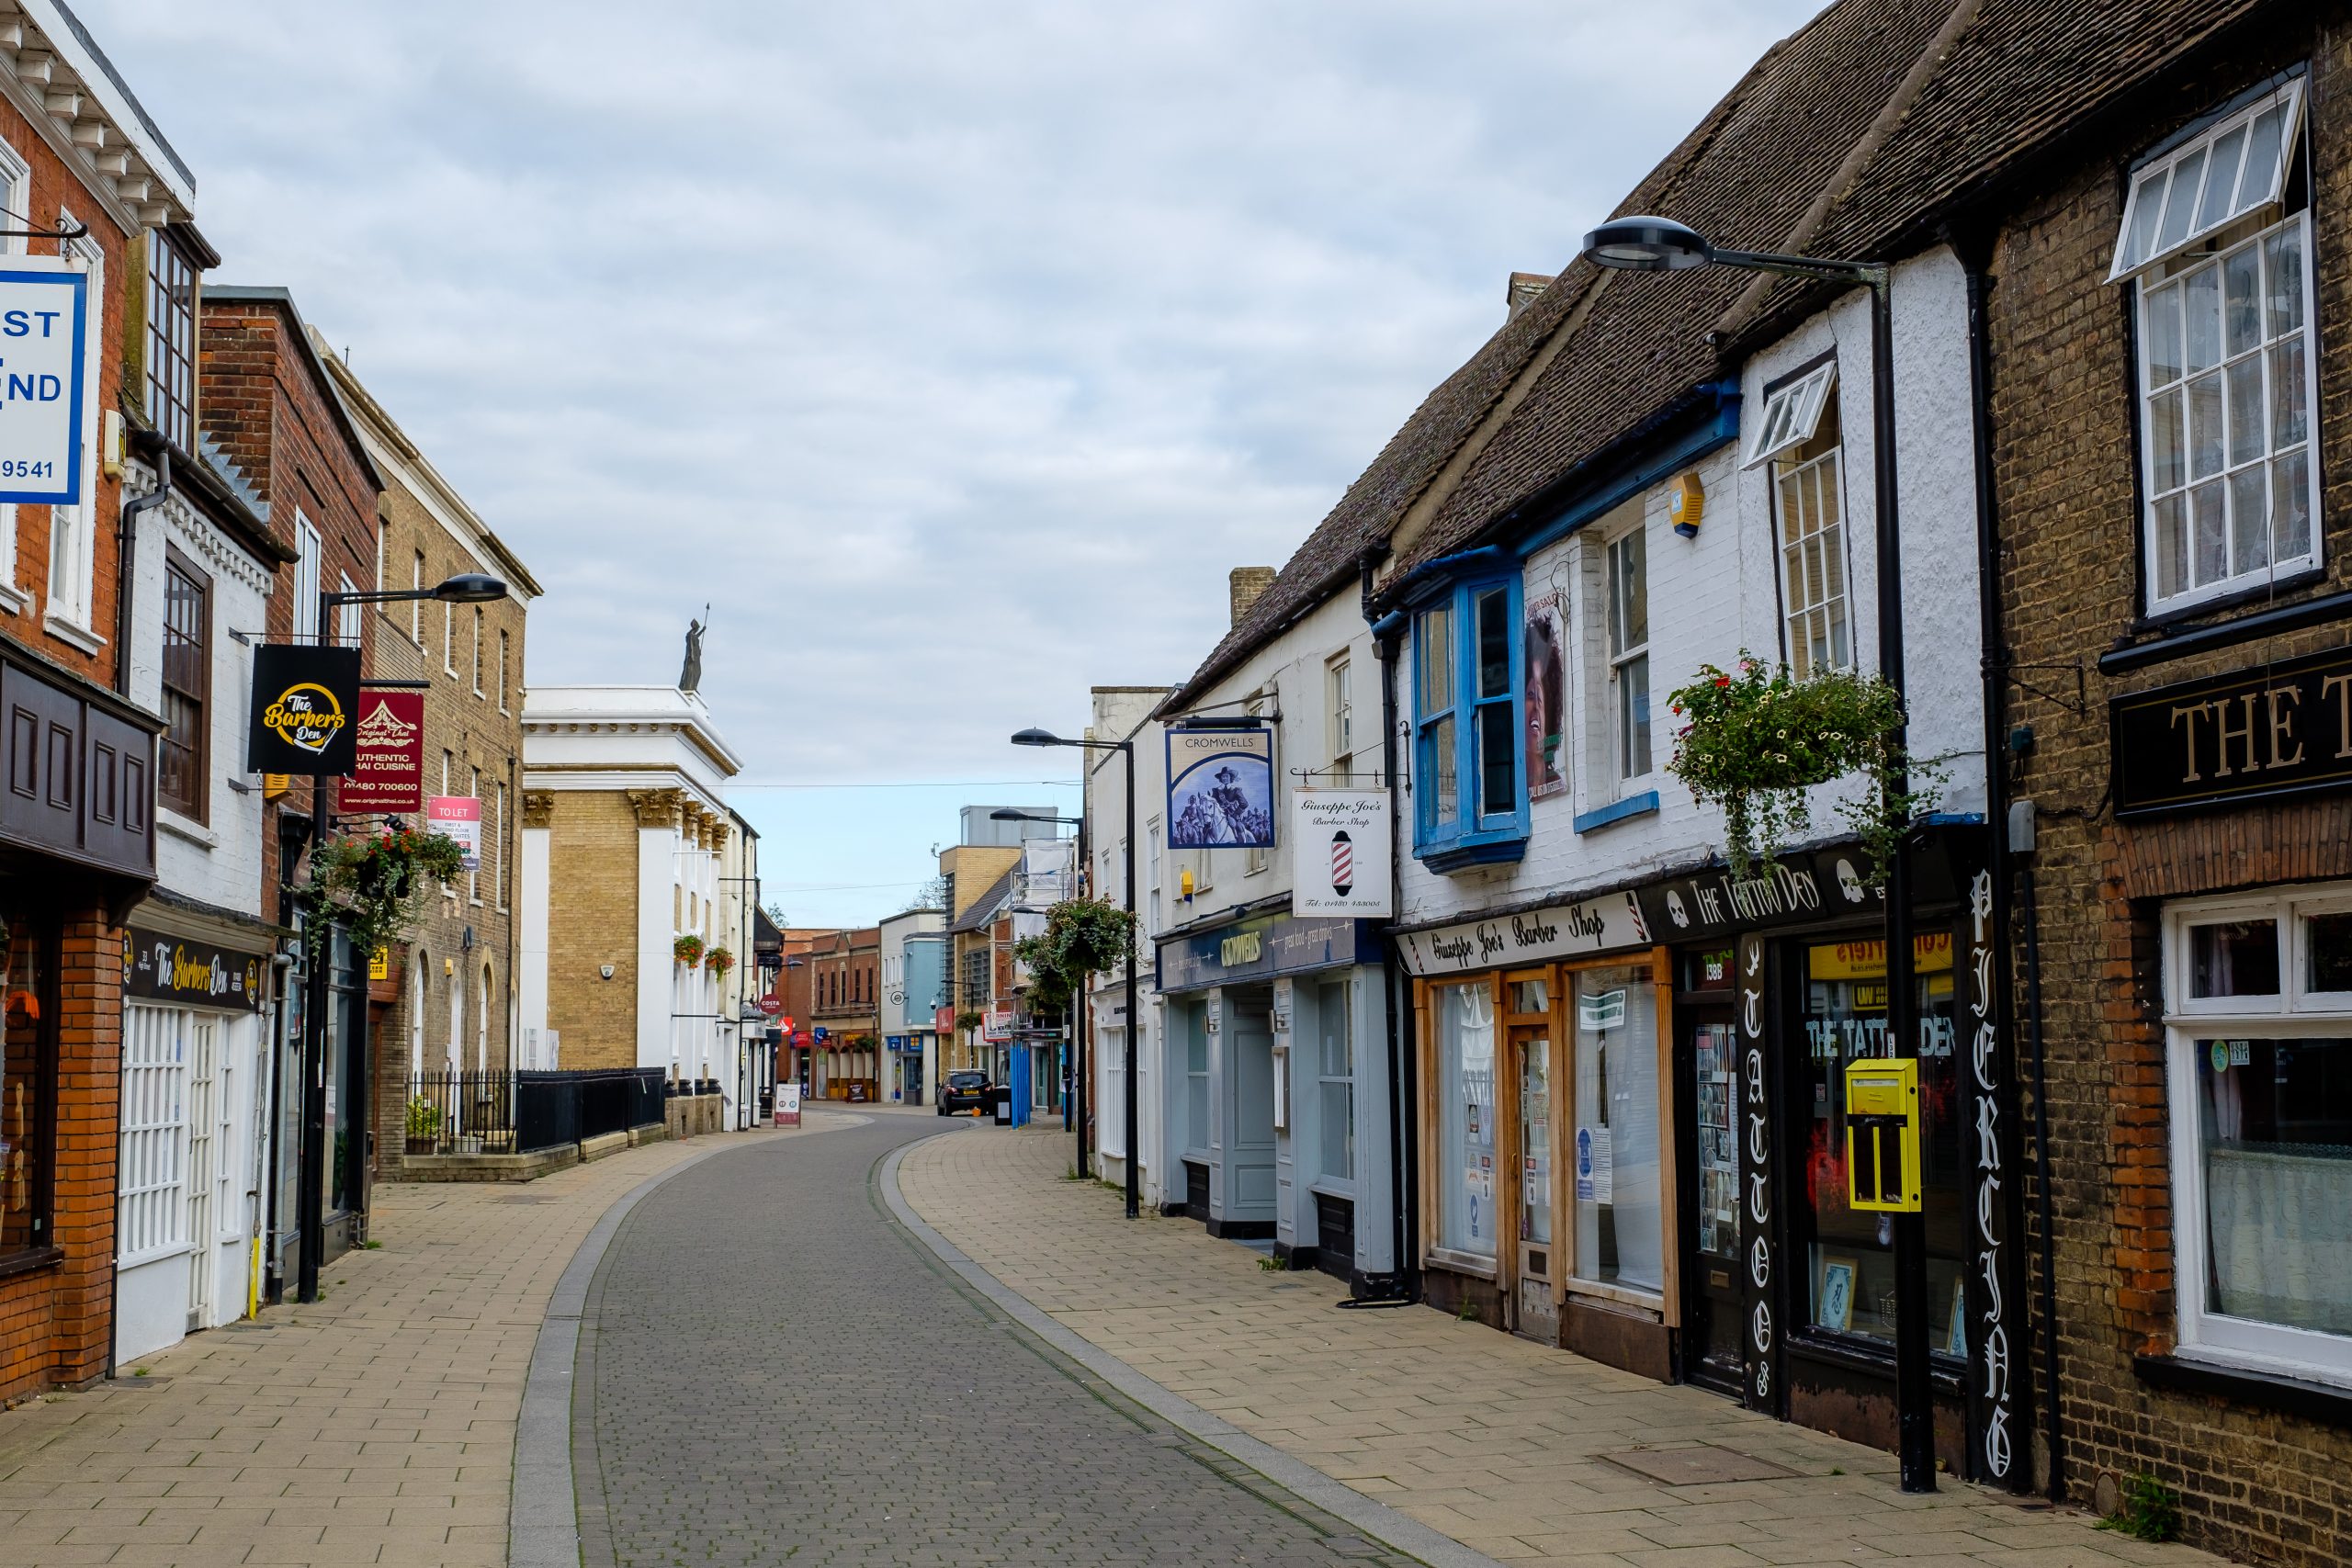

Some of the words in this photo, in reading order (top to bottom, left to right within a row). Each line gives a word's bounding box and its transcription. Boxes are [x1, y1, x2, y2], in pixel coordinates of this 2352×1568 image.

[3, 310, 61, 338] ST
[7, 373, 62, 401] ND
[3, 460, 52, 478] 9541
[287, 695, 313, 712] The
[264, 703, 345, 728] Barbers
[296, 726, 322, 740] Den
[388, 728, 410, 738] Thai
[1185, 738, 1253, 748] CROMWELLS
[2171, 684, 2304, 783] THE
[356, 754, 410, 762] UTHENTIC
[356, 762, 371, 771] HAI
[373, 762, 416, 771] CUISINE
[379, 783, 418, 791] 700600
[438, 807, 451, 817] TO
[452, 808, 469, 818] LET
[1301, 799, 1351, 814] Giuseppe
[1351, 800, 1382, 814] Joe's
[1312, 817, 1345, 826] Barber
[1347, 817, 1370, 828] Shop
[1689, 878, 1727, 924] THE
[1779, 864, 1820, 911] DEN
[1284, 933, 1295, 955] great
[1295, 926, 1305, 947] food
[1307, 928, 1318, 950] great
[1318, 921, 1333, 942] drinks
[1430, 931, 1474, 967] Giuseppe
[1476, 923, 1504, 964] Joe's
[1511, 914, 1558, 947] Barber
[1568, 904, 1605, 947] Shop
[1221, 931, 1261, 967] CROMWELLS
[155, 942, 173, 987] The
[174, 944, 210, 991] Barbers
[209, 953, 228, 997] Den
[1706, 963, 1723, 981] 138B
[1805, 1020, 1838, 1057] THE
[1842, 1019, 1889, 1057] TATT
[1918, 1017, 1956, 1056] DEN
[1970, 868, 2011, 1478] PIERCING
[1744, 988, 1771, 1397] TATTOOS
